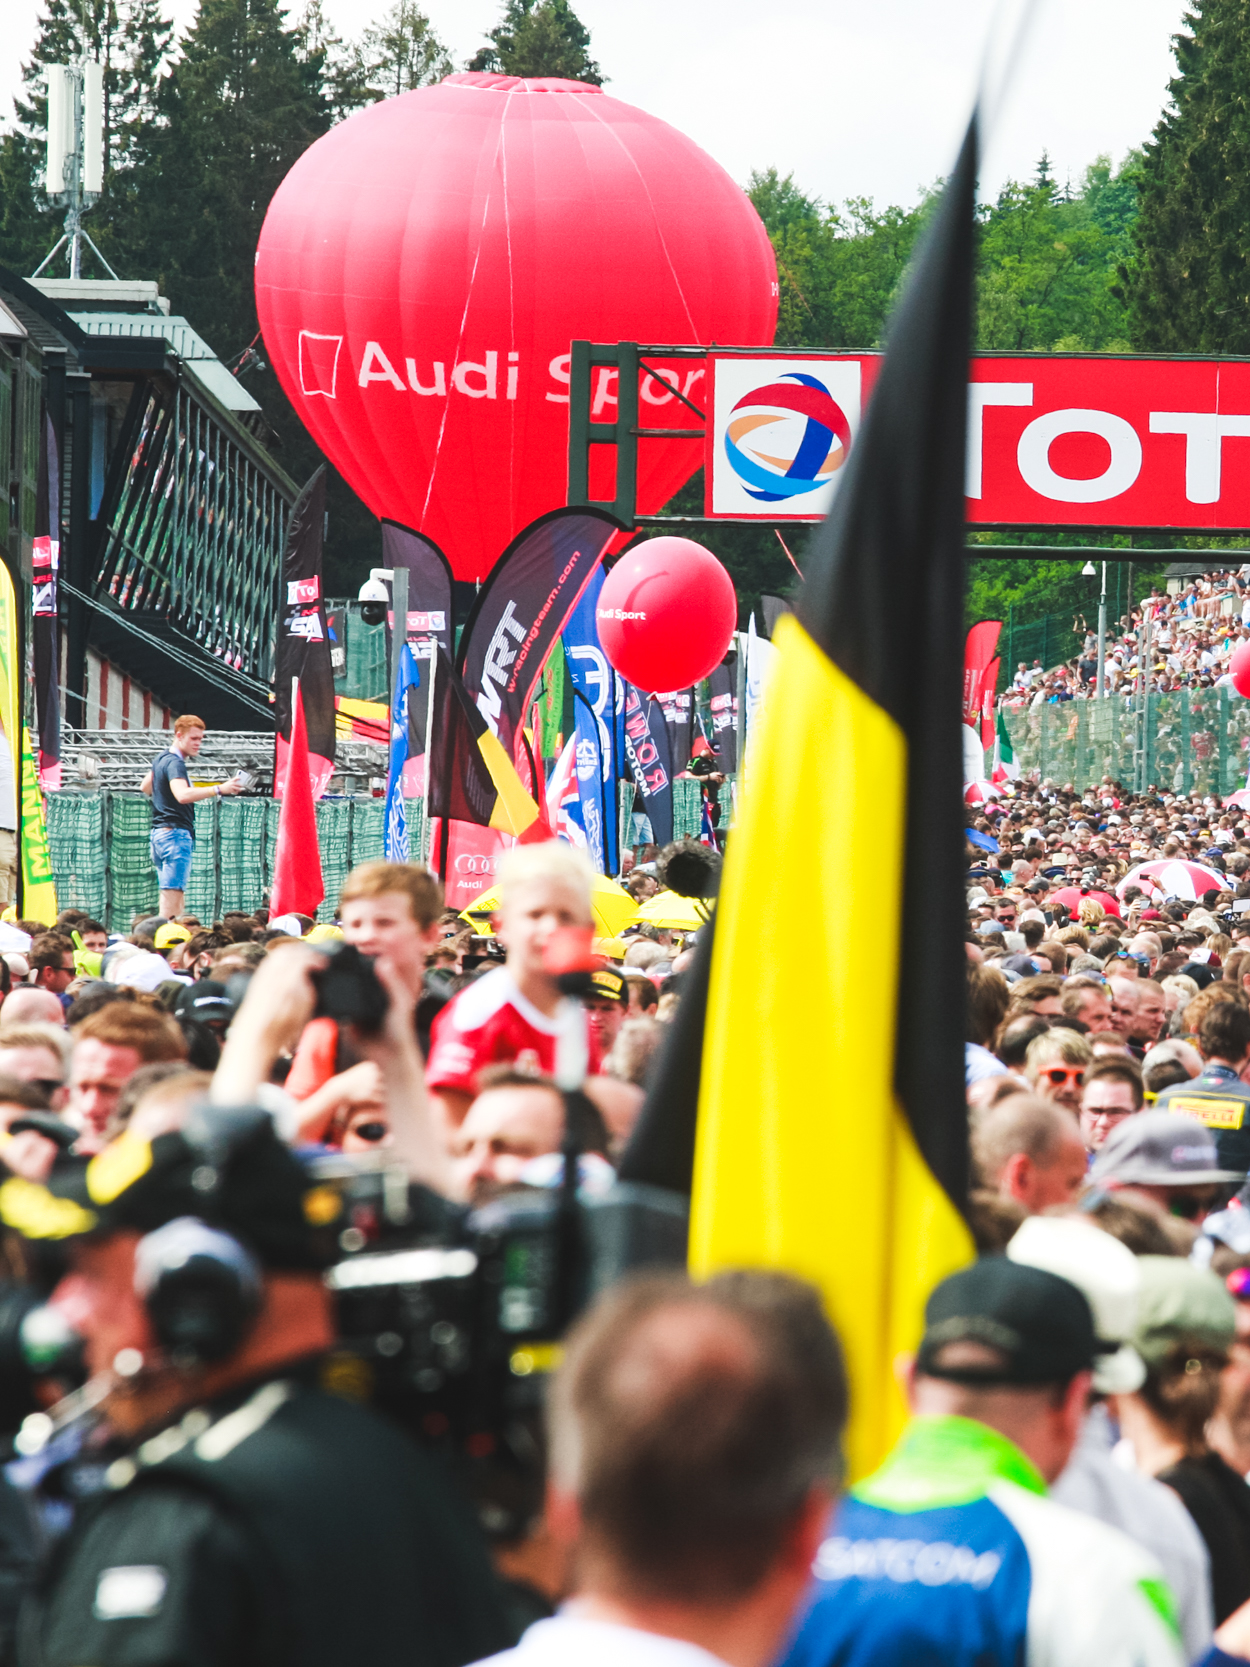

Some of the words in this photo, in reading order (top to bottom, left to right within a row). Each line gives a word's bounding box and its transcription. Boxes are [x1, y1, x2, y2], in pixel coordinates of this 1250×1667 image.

[358, 340, 519, 401] Audi
[599, 608, 614, 618] Audi
[615, 608, 647, 621] Sport
[476, 600, 528, 738] WRT
[457, 880, 482, 889] Audi
